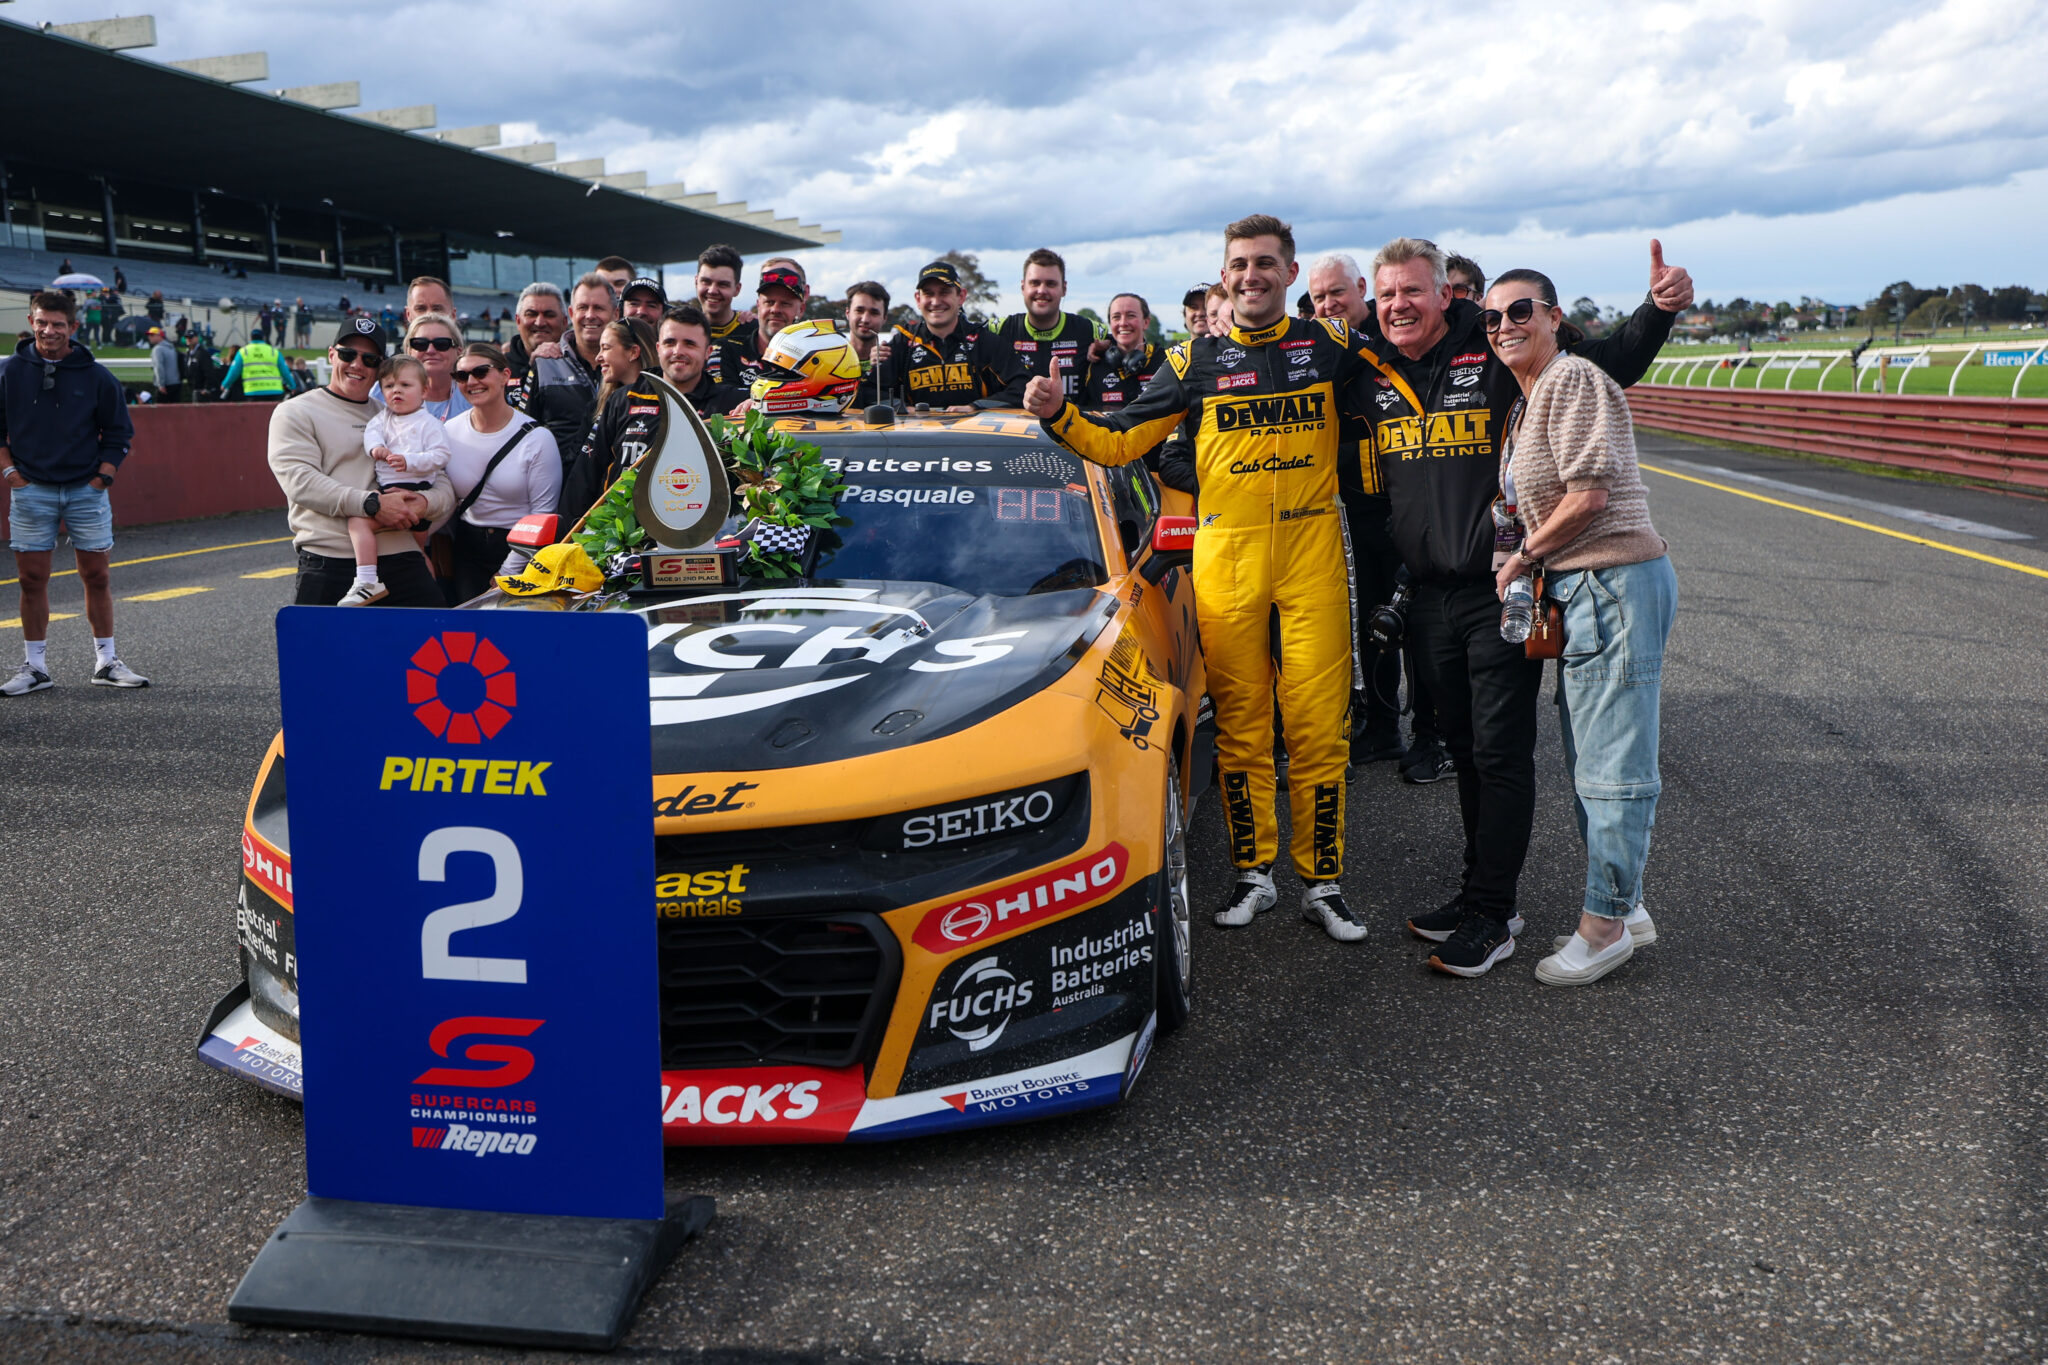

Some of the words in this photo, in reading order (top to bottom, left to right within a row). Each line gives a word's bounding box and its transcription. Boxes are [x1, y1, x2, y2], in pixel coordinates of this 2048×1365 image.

[1250, 329, 1277, 343] DEWALT
[1216, 350, 1246, 363] FUCHS
[1286, 349, 1313, 358] SEIKO
[1458, 355, 1485, 363] HINO
[1230, 372, 1255, 382] HUNGRY
[1449, 366, 1483, 377] SEIKO
[1444, 392, 1470, 400] Industrial
[1216, 394, 1326, 431] DEWALT
[1250, 421, 1326, 436] RACING
[823, 457, 992, 472] Batteries
[1230, 459, 1260, 475] Cub
[1262, 453, 1314, 475] Cadet
[841, 485, 975, 508] Pasquale
[558, 576, 575, 585] 2nd
[379, 756, 553, 796] PIRTEK
[903, 790, 1053, 848] SEIKO
[1224, 771, 1257, 864] DEWALT
[1314, 782, 1339, 877] DEWALT
[995, 856, 1116, 922] HINO
[418, 826, 527, 984] 2
[656, 896, 742, 919] rentals
[1051, 911, 1154, 968] Industrial
[1051, 945, 1153, 993] Batteries
[930, 980, 1034, 1029] FUCHS
[1052, 983, 1105, 1009] Australia
[238, 1053, 303, 1088] MOTORS
[970, 1083, 1020, 1101] BARRY
[1022, 1072, 1082, 1090] BOURKE
[979, 1082, 1090, 1113] MOTORS
[410, 1093, 537, 1113] SUPERCARS
[410, 1108, 537, 1125] CHAMPIONSHIP
[440, 1123, 538, 1158] Repco
